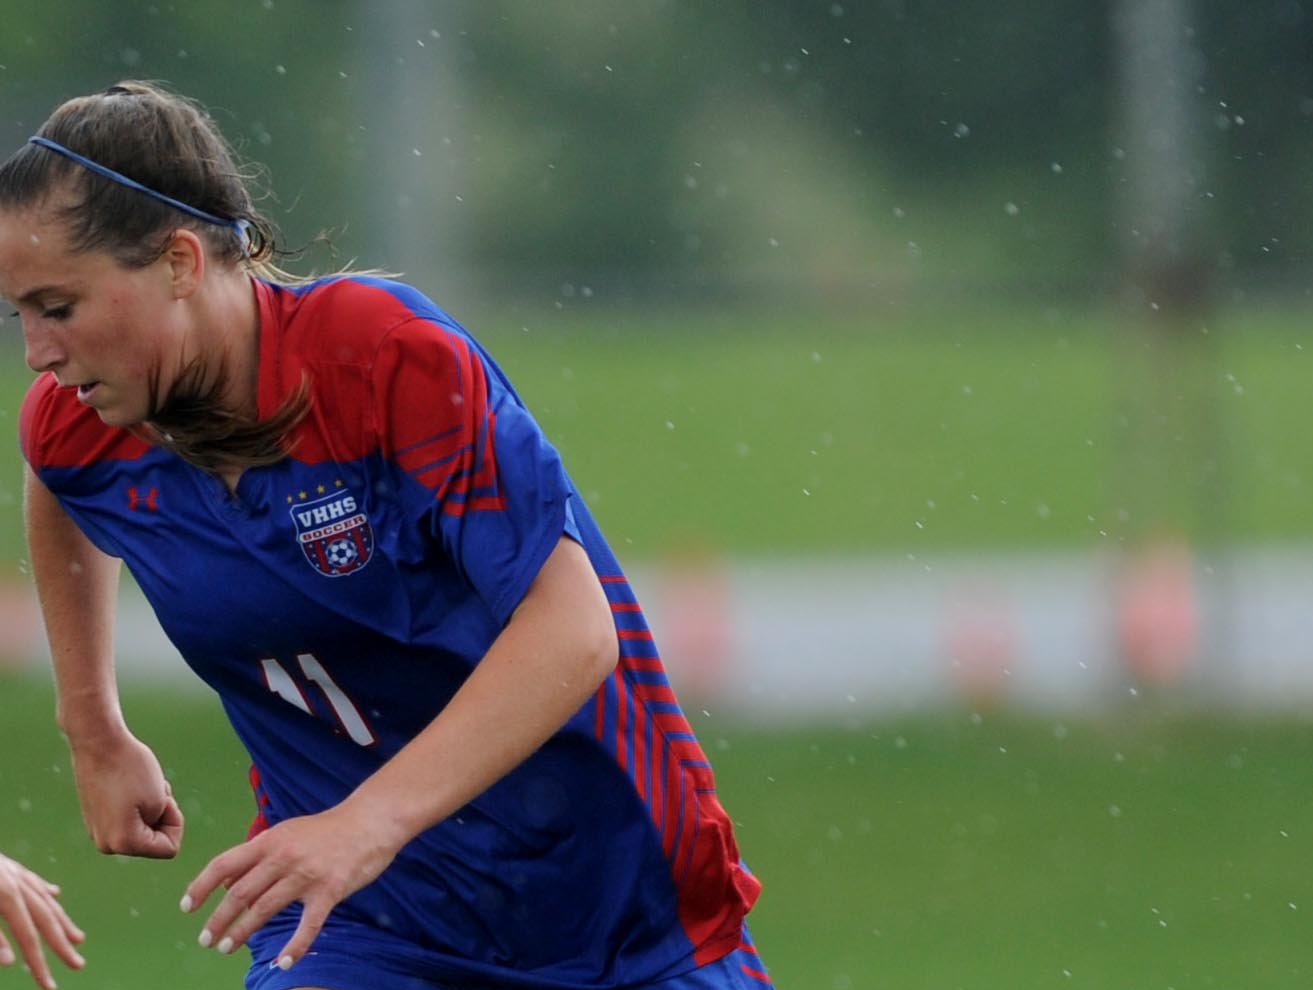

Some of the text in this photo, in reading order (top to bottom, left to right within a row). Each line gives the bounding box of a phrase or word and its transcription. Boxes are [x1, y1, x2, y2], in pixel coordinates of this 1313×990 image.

[297, 496, 357, 528] VHHS
[301, 514, 364, 542] SOCCER
[261, 653, 375, 747] 11
